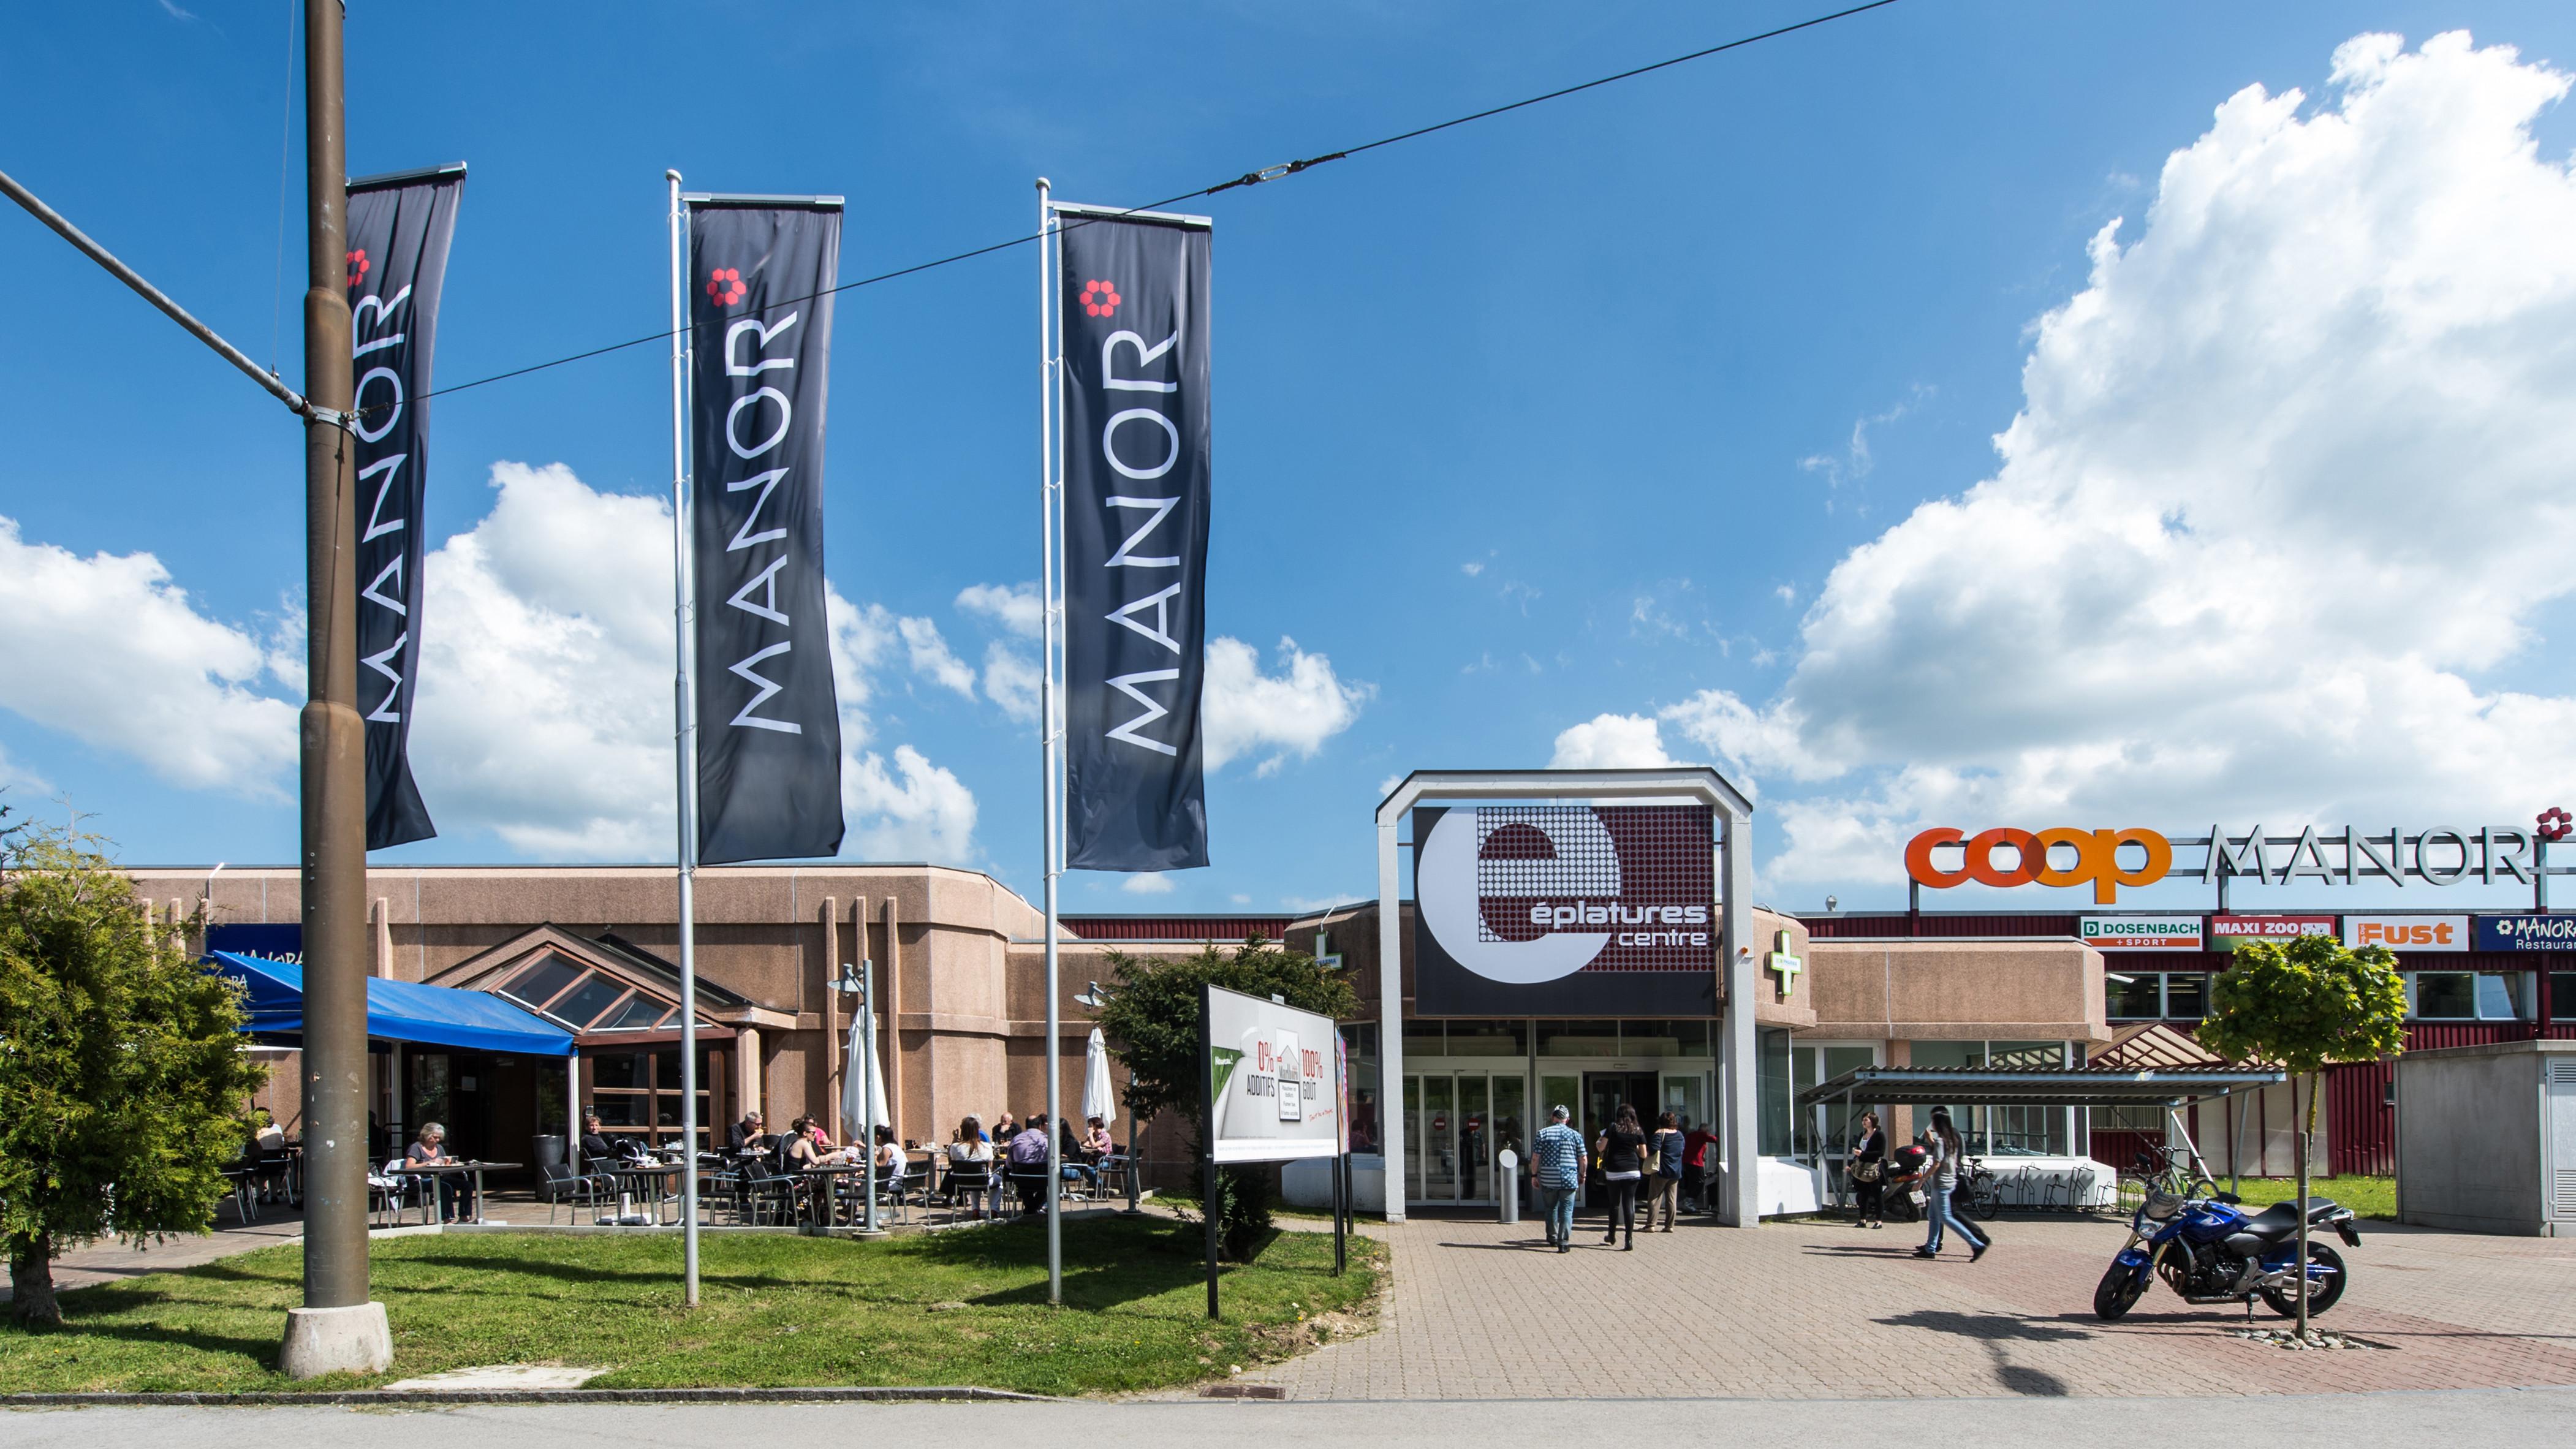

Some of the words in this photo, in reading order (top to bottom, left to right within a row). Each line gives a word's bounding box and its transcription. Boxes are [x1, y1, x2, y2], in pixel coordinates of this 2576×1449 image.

[352, 284, 411, 722] MANOR
[725, 310, 801, 735] MANOR
[1103, 329, 1181, 756] MANOR
[1904, 827, 2172, 904] coop
[2202, 823, 2535, 887] MANOR
[1531, 900, 1707, 929] éplatures
[2104, 923, 2200, 934] DOSENBACH
[2214, 922, 2260, 934] MAXI
[2265, 922, 2299, 934] ZOO
[1618, 929, 1707, 946] centre
[2358, 922, 2453, 945] Fust
[1258, 1041, 1274, 1072] 0%
[1301, 1048, 1323, 1078] 100%
[1247, 1074, 1275, 1097] ADDITIFS
[1303, 1078, 1316, 1100] GOÛT
